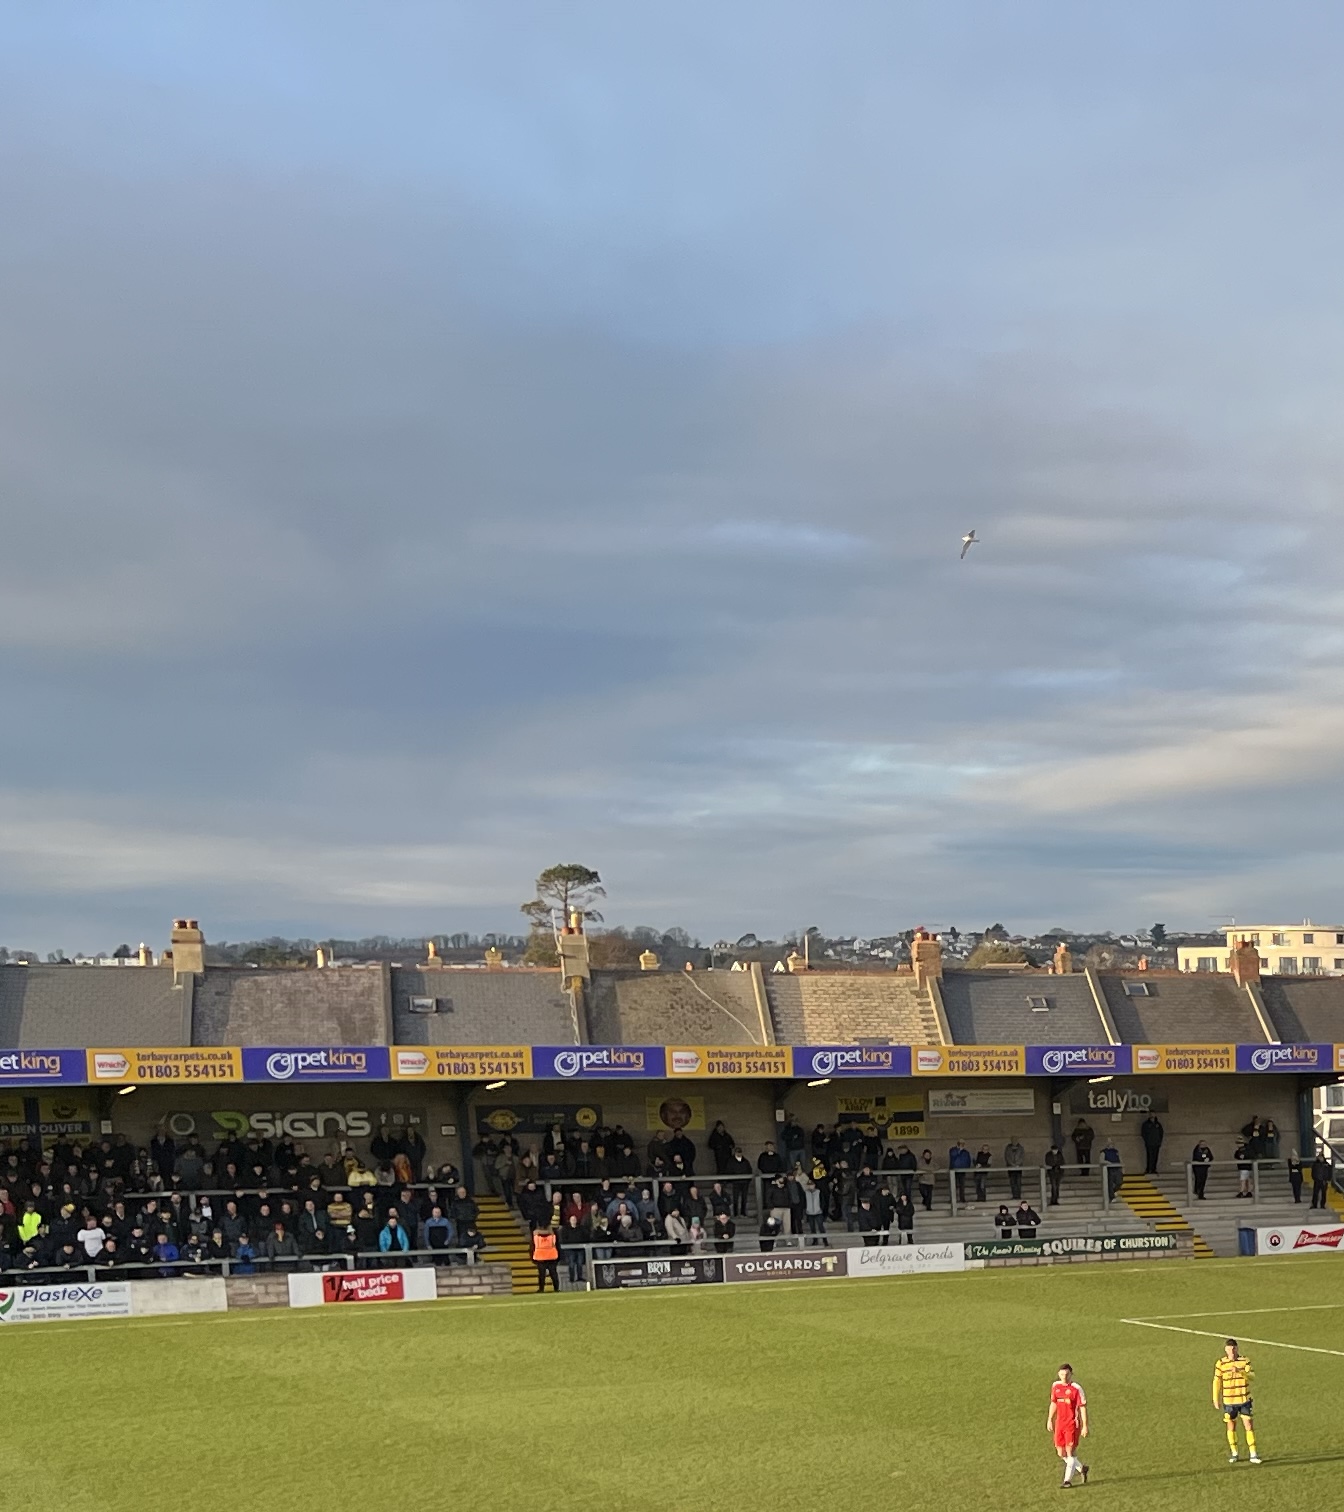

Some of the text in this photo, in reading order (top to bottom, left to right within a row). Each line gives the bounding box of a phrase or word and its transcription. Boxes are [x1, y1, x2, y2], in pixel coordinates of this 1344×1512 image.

[437, 1061, 525, 1075] 01803 554151
[707, 1061, 786, 1074] 01803 554151
[948, 1060, 1019, 1072] 01803 554151
[1166, 1058, 1230, 1069] 01803 554151
[137, 1064, 235, 1078] 01803 554151
[39, 1122, 83, 1134] OLIVER
[893, 1125, 920, 1136] 1899
[1042, 1238, 1103, 1255] SQUIRES
[1103, 1237, 1117, 1250] OF
[1119, 1236, 1169, 1249] CHURSTON
[860, 1245, 954, 1266] Belgrave Sands
[735, 1259, 821, 1274] TOLCHARDS
[342, 1273, 400, 1291] half price
